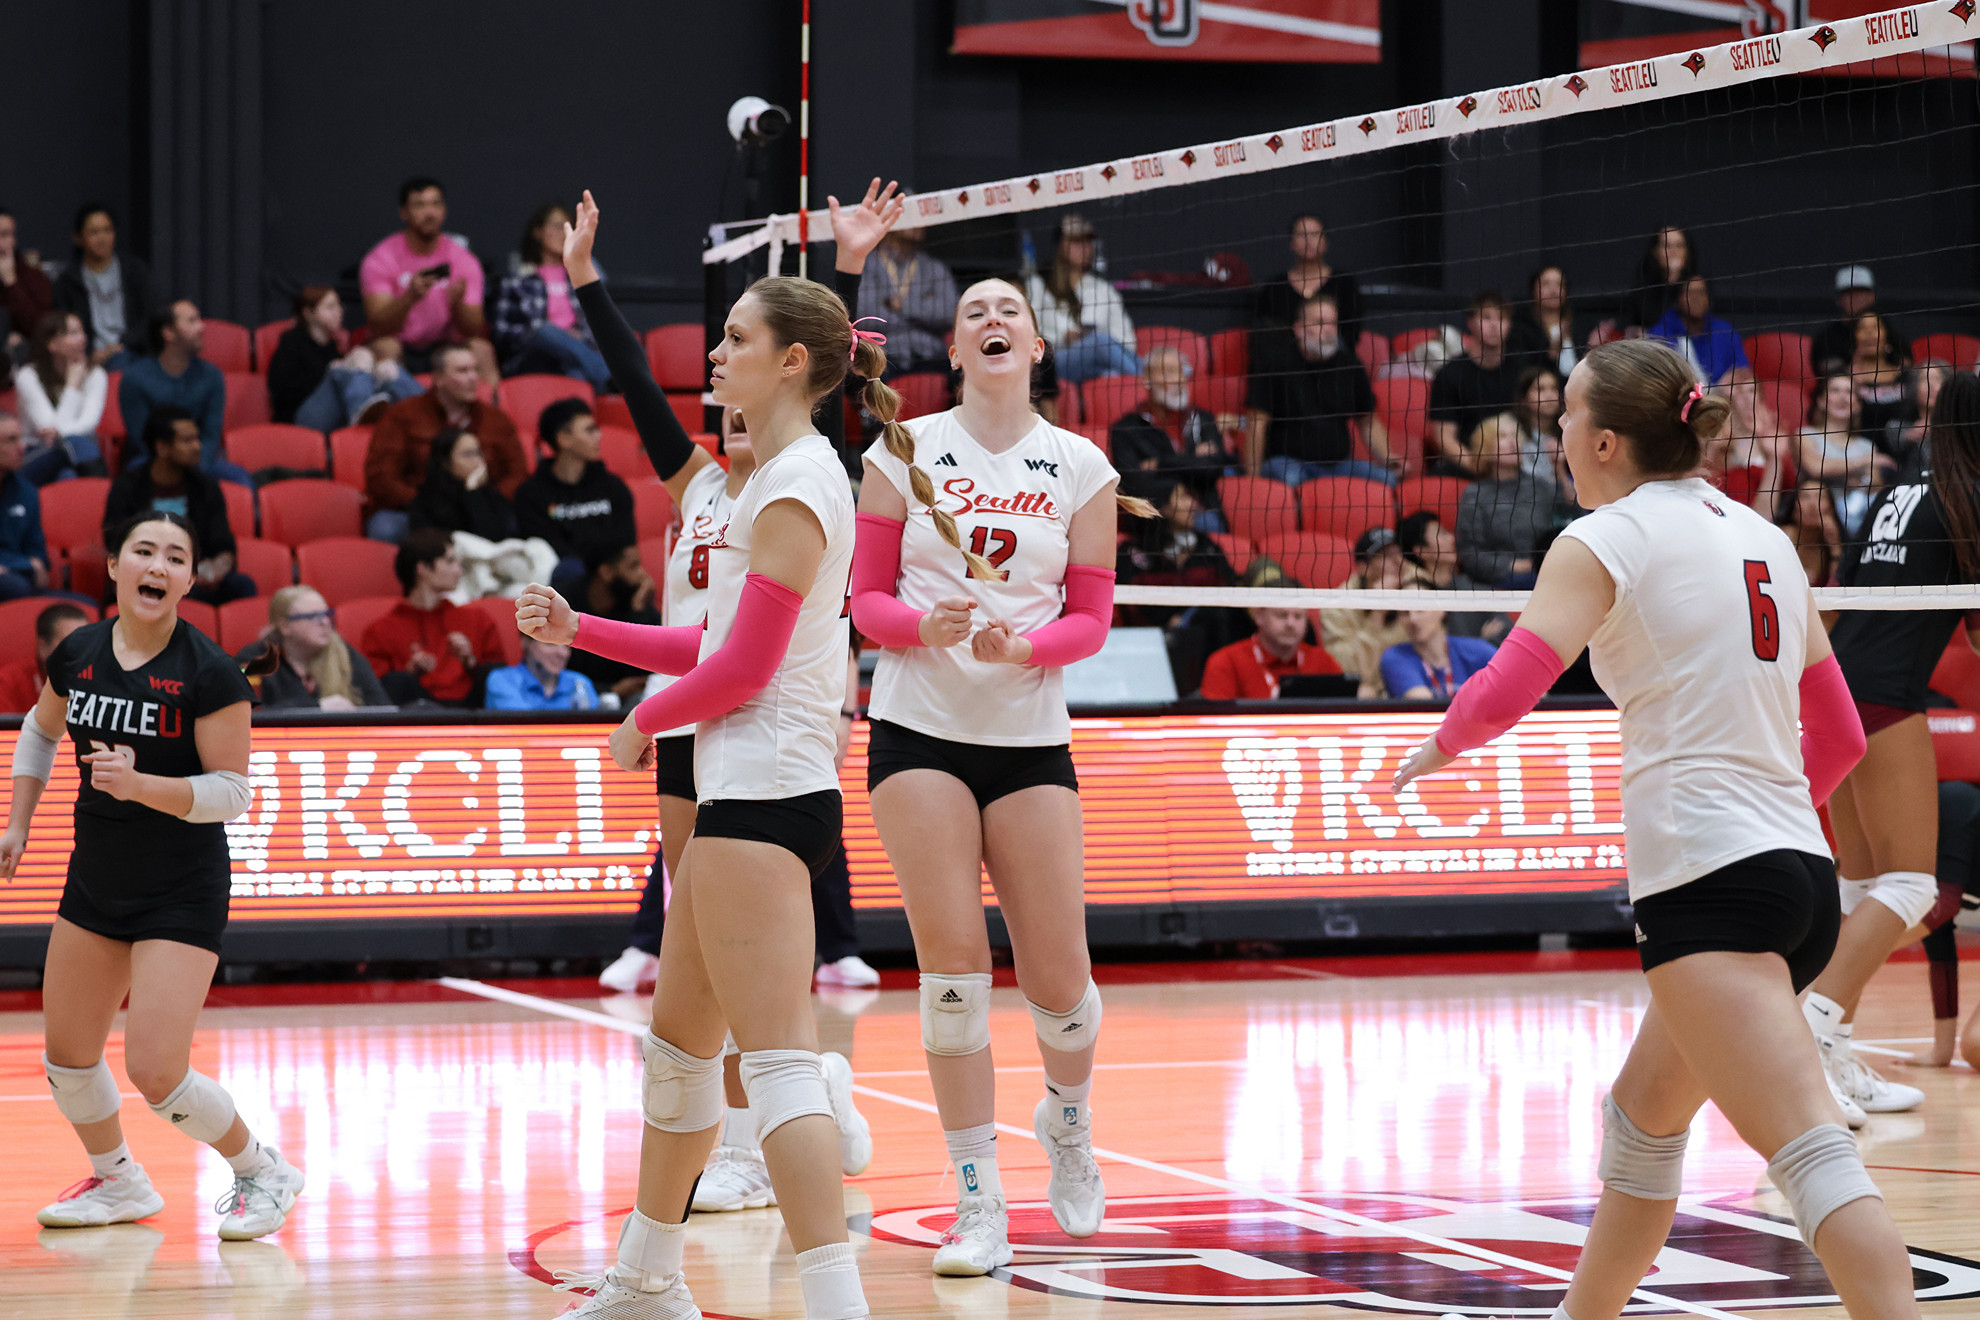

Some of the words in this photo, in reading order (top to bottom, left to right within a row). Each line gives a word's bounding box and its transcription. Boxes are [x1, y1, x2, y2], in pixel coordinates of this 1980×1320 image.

[1300, 124, 1337, 152] SEATTLEU
[1396, 104, 1436, 134] SEATTLEU
[1497, 86, 1542, 115] SEATTLEU
[1608, 62, 1658, 93] SEATTLEU
[1729, 37, 1782, 71] SEATTLEU
[1864, 9, 1919, 46] SEATTLEU
[925, 477, 1061, 521] Seattle
[965, 525, 1018, 583] 12
[1742, 558, 1780, 663] 6
[149, 675, 185, 696] WCC
